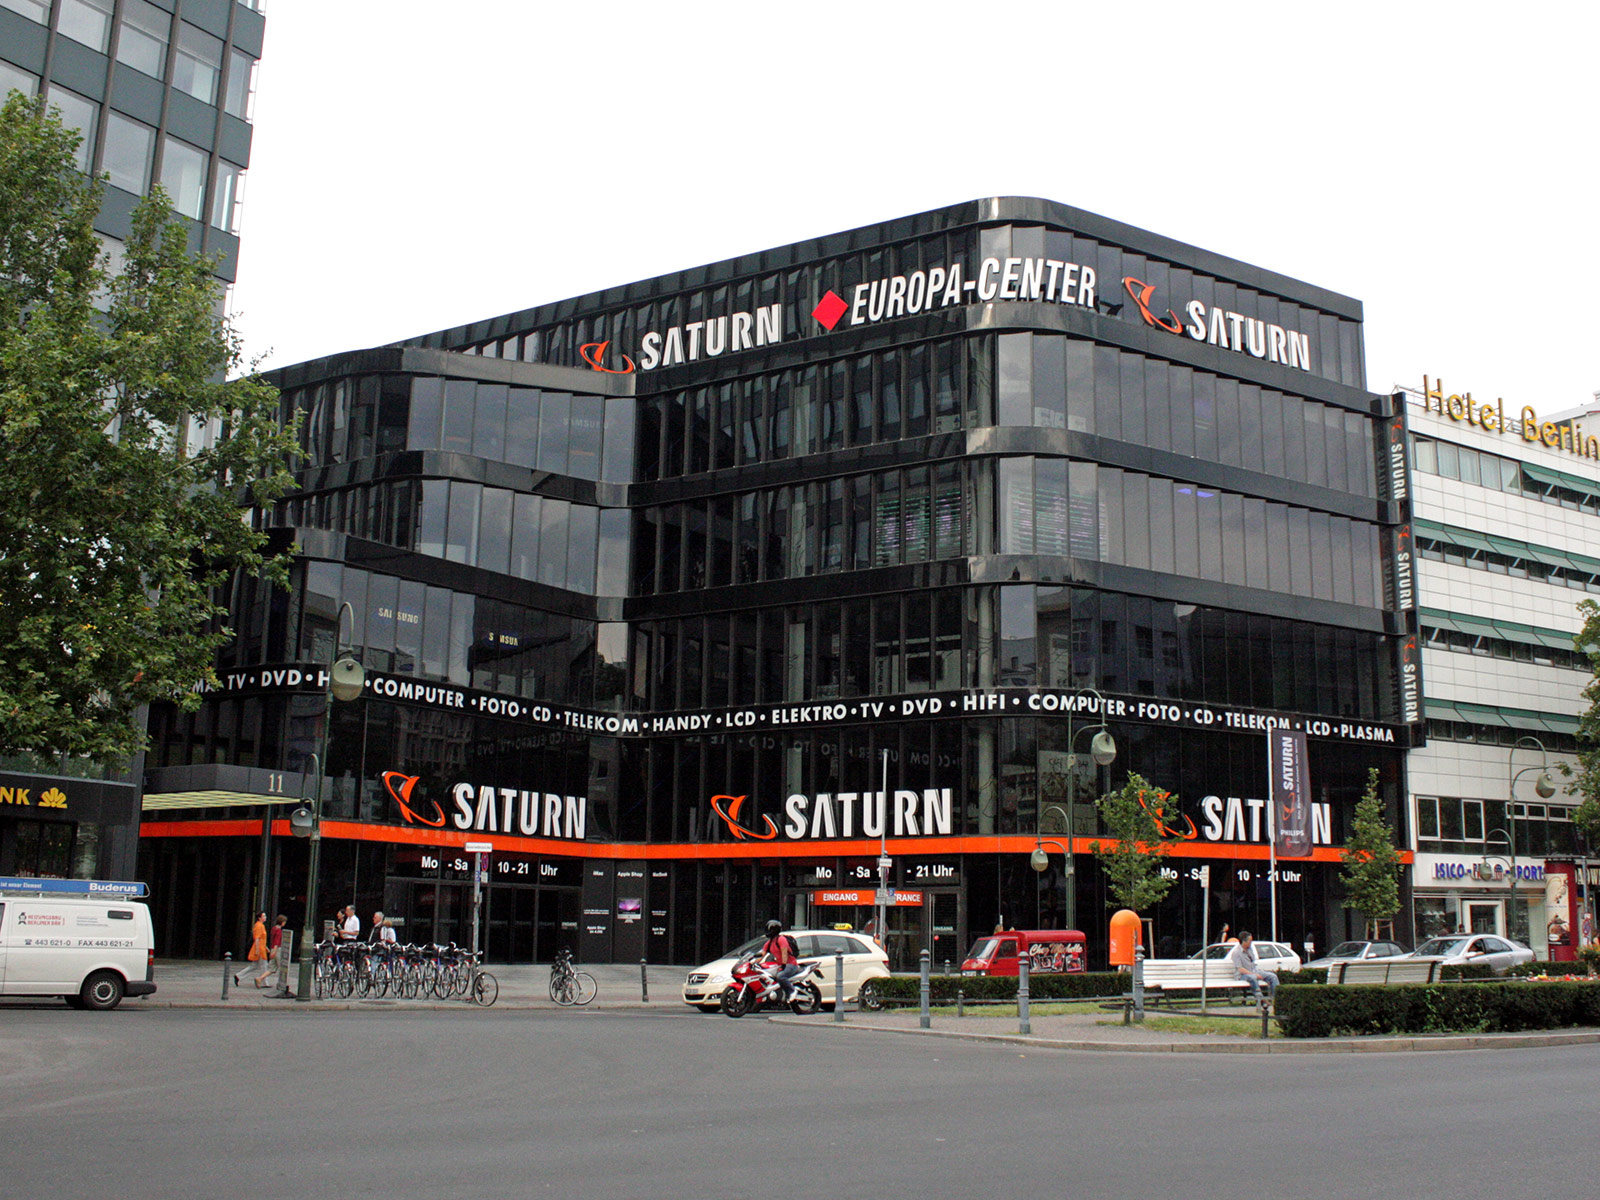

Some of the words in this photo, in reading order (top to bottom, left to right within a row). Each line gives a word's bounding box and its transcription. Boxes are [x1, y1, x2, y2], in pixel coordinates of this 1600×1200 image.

[850, 257, 1097, 327] EUROPA-CENTER
[640, 303, 782, 371] SATURN
[1186, 299, 1311, 372] SATURN
[1423, 374, 1507, 434] Hotel
[1521, 404, 1600, 461] Berlin
[1390, 443, 1406, 499] SATURN
[1397, 552, 1412, 610] SATURN
[227, 673, 247, 690] TV
[260, 669, 301, 687] DVD
[373, 677, 465, 708] COMPUTER
[479, 696, 520, 717] FOTO
[532, 706, 551, 722] CD
[563, 711, 639, 732] TELEKOM
[1403, 663, 1419, 722] SATURN
[652, 714, 712, 732] HANDY
[725, 711, 756, 727] LCD
[771, 703, 847, 724] ELEKTRO
[860, 702, 884, 718] TV
[902, 698, 942, 715] DVD
[963, 694, 1005, 711] HIFI
[1028, 693, 1126, 717] COMPUTER
[1137, 702, 1181, 722] FOTO
[1194, 708, 1214, 725] CD
[1225, 711, 1290, 730] TELEKOM
[1306, 720, 1331, 736] LCD
[1340, 723, 1395, 742] PLASMA
[268, 773, 283, 793] 11
[1281, 736, 1294, 791] SATURN
[452, 781, 587, 840] SATURN
[785, 787, 954, 840] SATURN
[1201, 795, 1332, 845] SATN
[1280, 829, 1305, 837] PHILIPS
[89, 882, 138, 893] Buderus
[421, 855, 439, 869] Mo
[454, 858, 468, 871] Sa
[497, 861, 510, 873] 10
[517, 862, 529, 875] 21
[540, 863, 558, 877] Uhr
[815, 867, 832, 879] Mo
[856, 866, 871, 878] Sa
[916, 866, 929, 878] 21
[932, 864, 954, 878] Uhr
[1160, 867, 1178, 880] Mo
[1237, 869, 1250, 882] 10
[1282, 870, 1301, 883] Uhr
[823, 892, 858, 902] EINGANG
[35, 939, 49, 947] 443
[50, 939, 72, 947] 621-0
[78, 939, 94, 947] FAX
[95, 939, 109, 947] 443
[110, 939, 134, 948] 621-21
